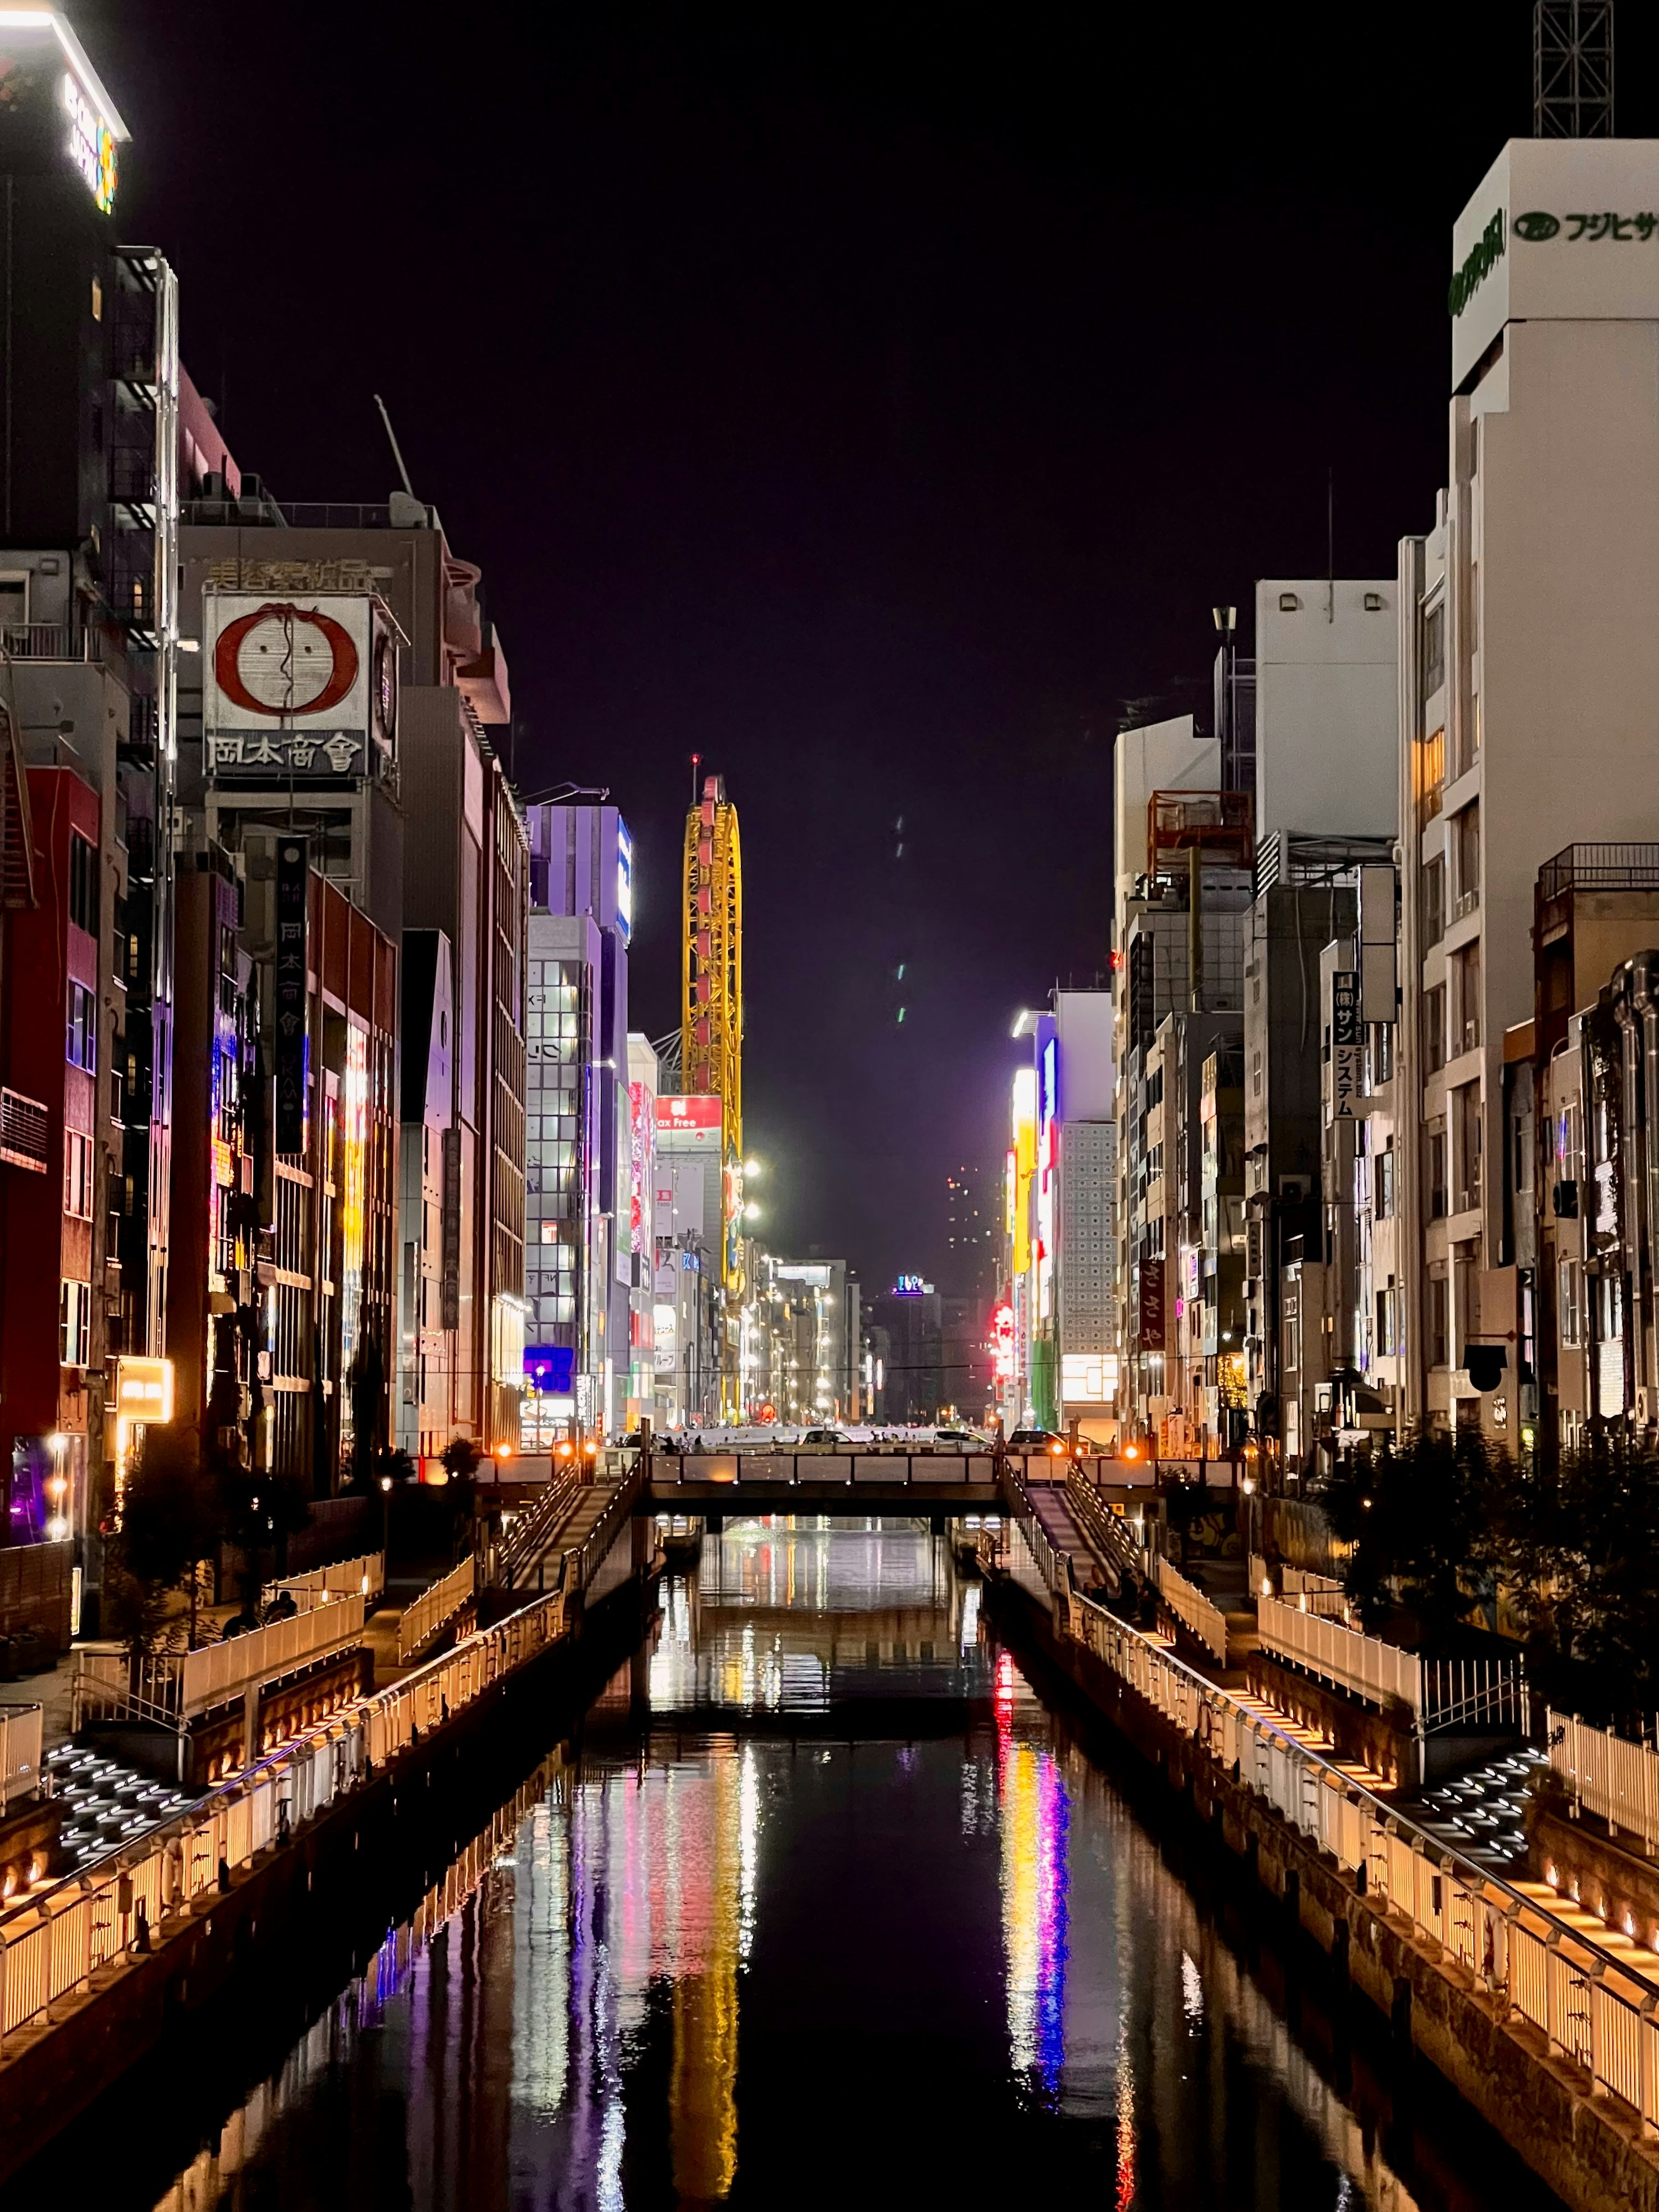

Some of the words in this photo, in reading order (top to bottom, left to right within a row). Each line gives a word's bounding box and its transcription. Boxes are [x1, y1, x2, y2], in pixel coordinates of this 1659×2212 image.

[674, 1118, 697, 1127] Free
[1143, 1264, 1162, 1346] ささや
